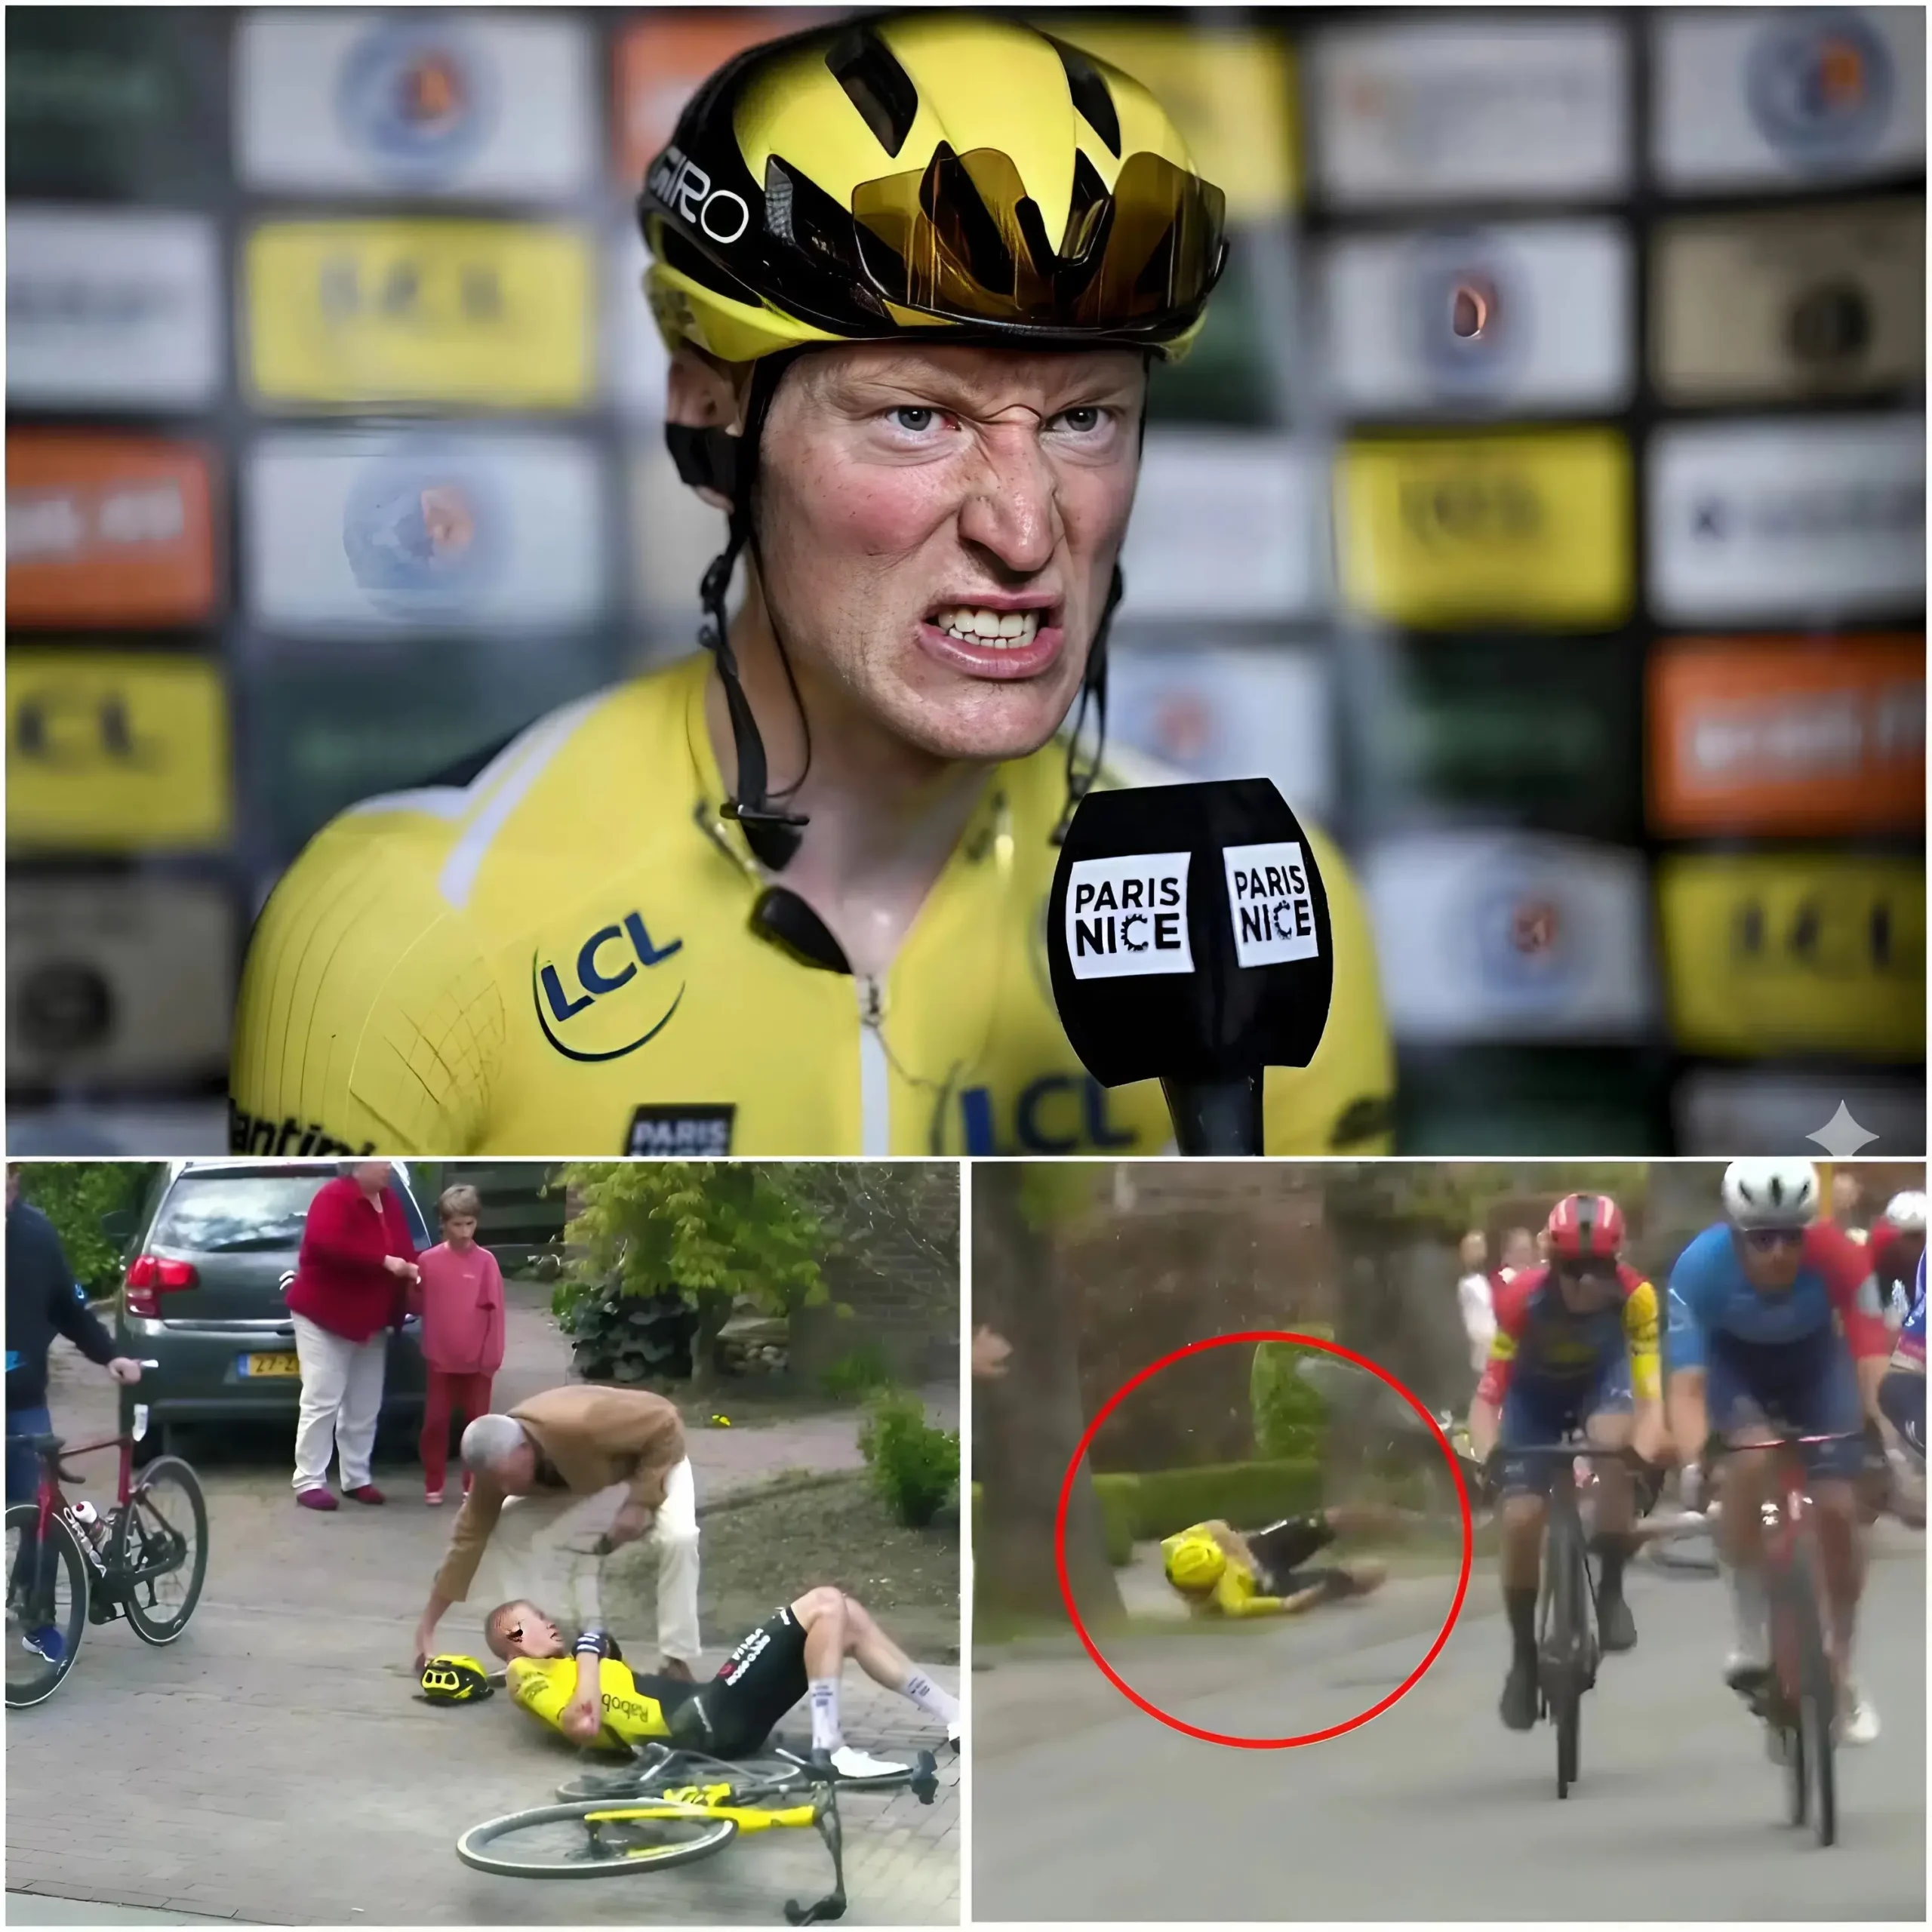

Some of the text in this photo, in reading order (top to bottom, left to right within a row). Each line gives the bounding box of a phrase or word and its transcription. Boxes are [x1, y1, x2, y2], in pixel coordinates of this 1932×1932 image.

[1075, 877, 1180, 914] PARIS
[1234, 865, 1306, 900] PARIS
[1075, 912, 1181, 957] NICE
[1240, 899, 1312, 943] NICE
[540, 910, 683, 1023] LCL
[632, 1119, 728, 1146] PARIS
[601, 1694, 648, 1723] Rabob
